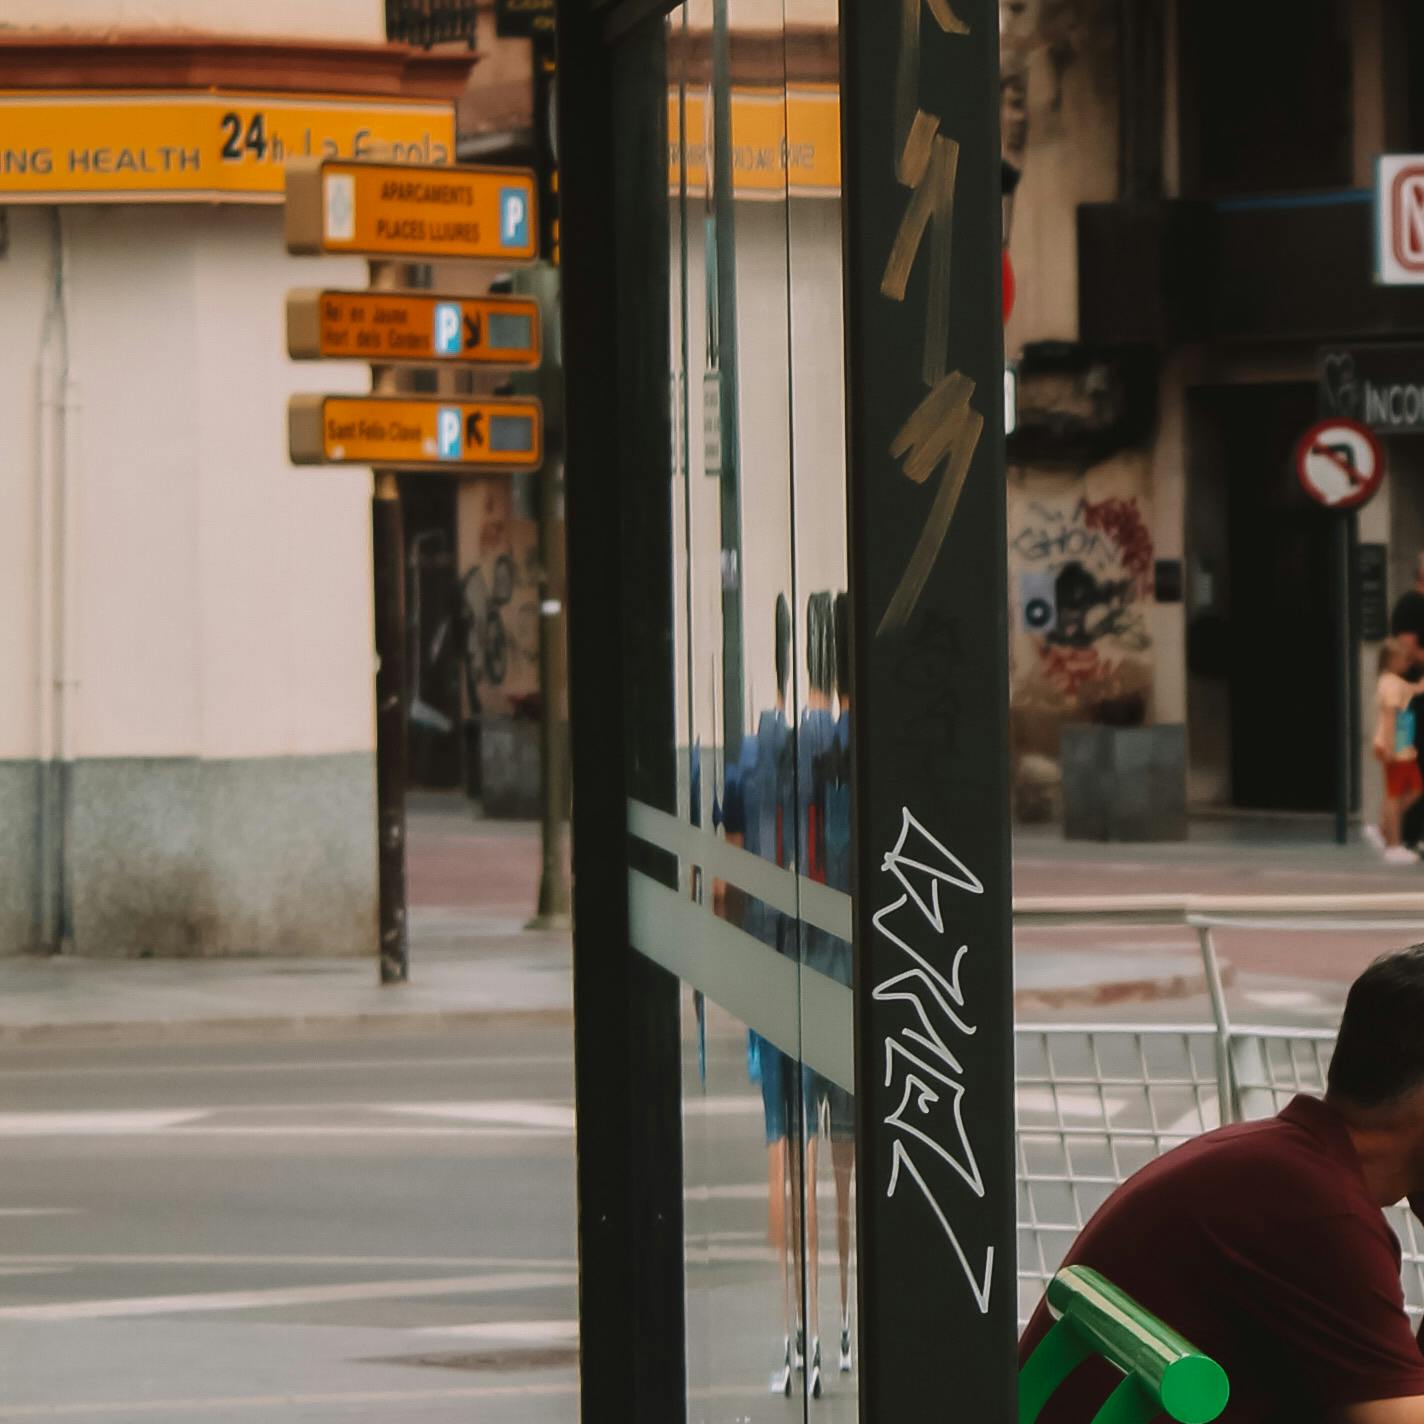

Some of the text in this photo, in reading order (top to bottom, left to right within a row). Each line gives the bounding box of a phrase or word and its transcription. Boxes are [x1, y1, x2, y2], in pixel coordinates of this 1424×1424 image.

[68, 148, 201, 174] HEALTH
[380, 181, 474, 207] APARCAMENTS
[376, 217, 480, 244] PLACES LLIURES
